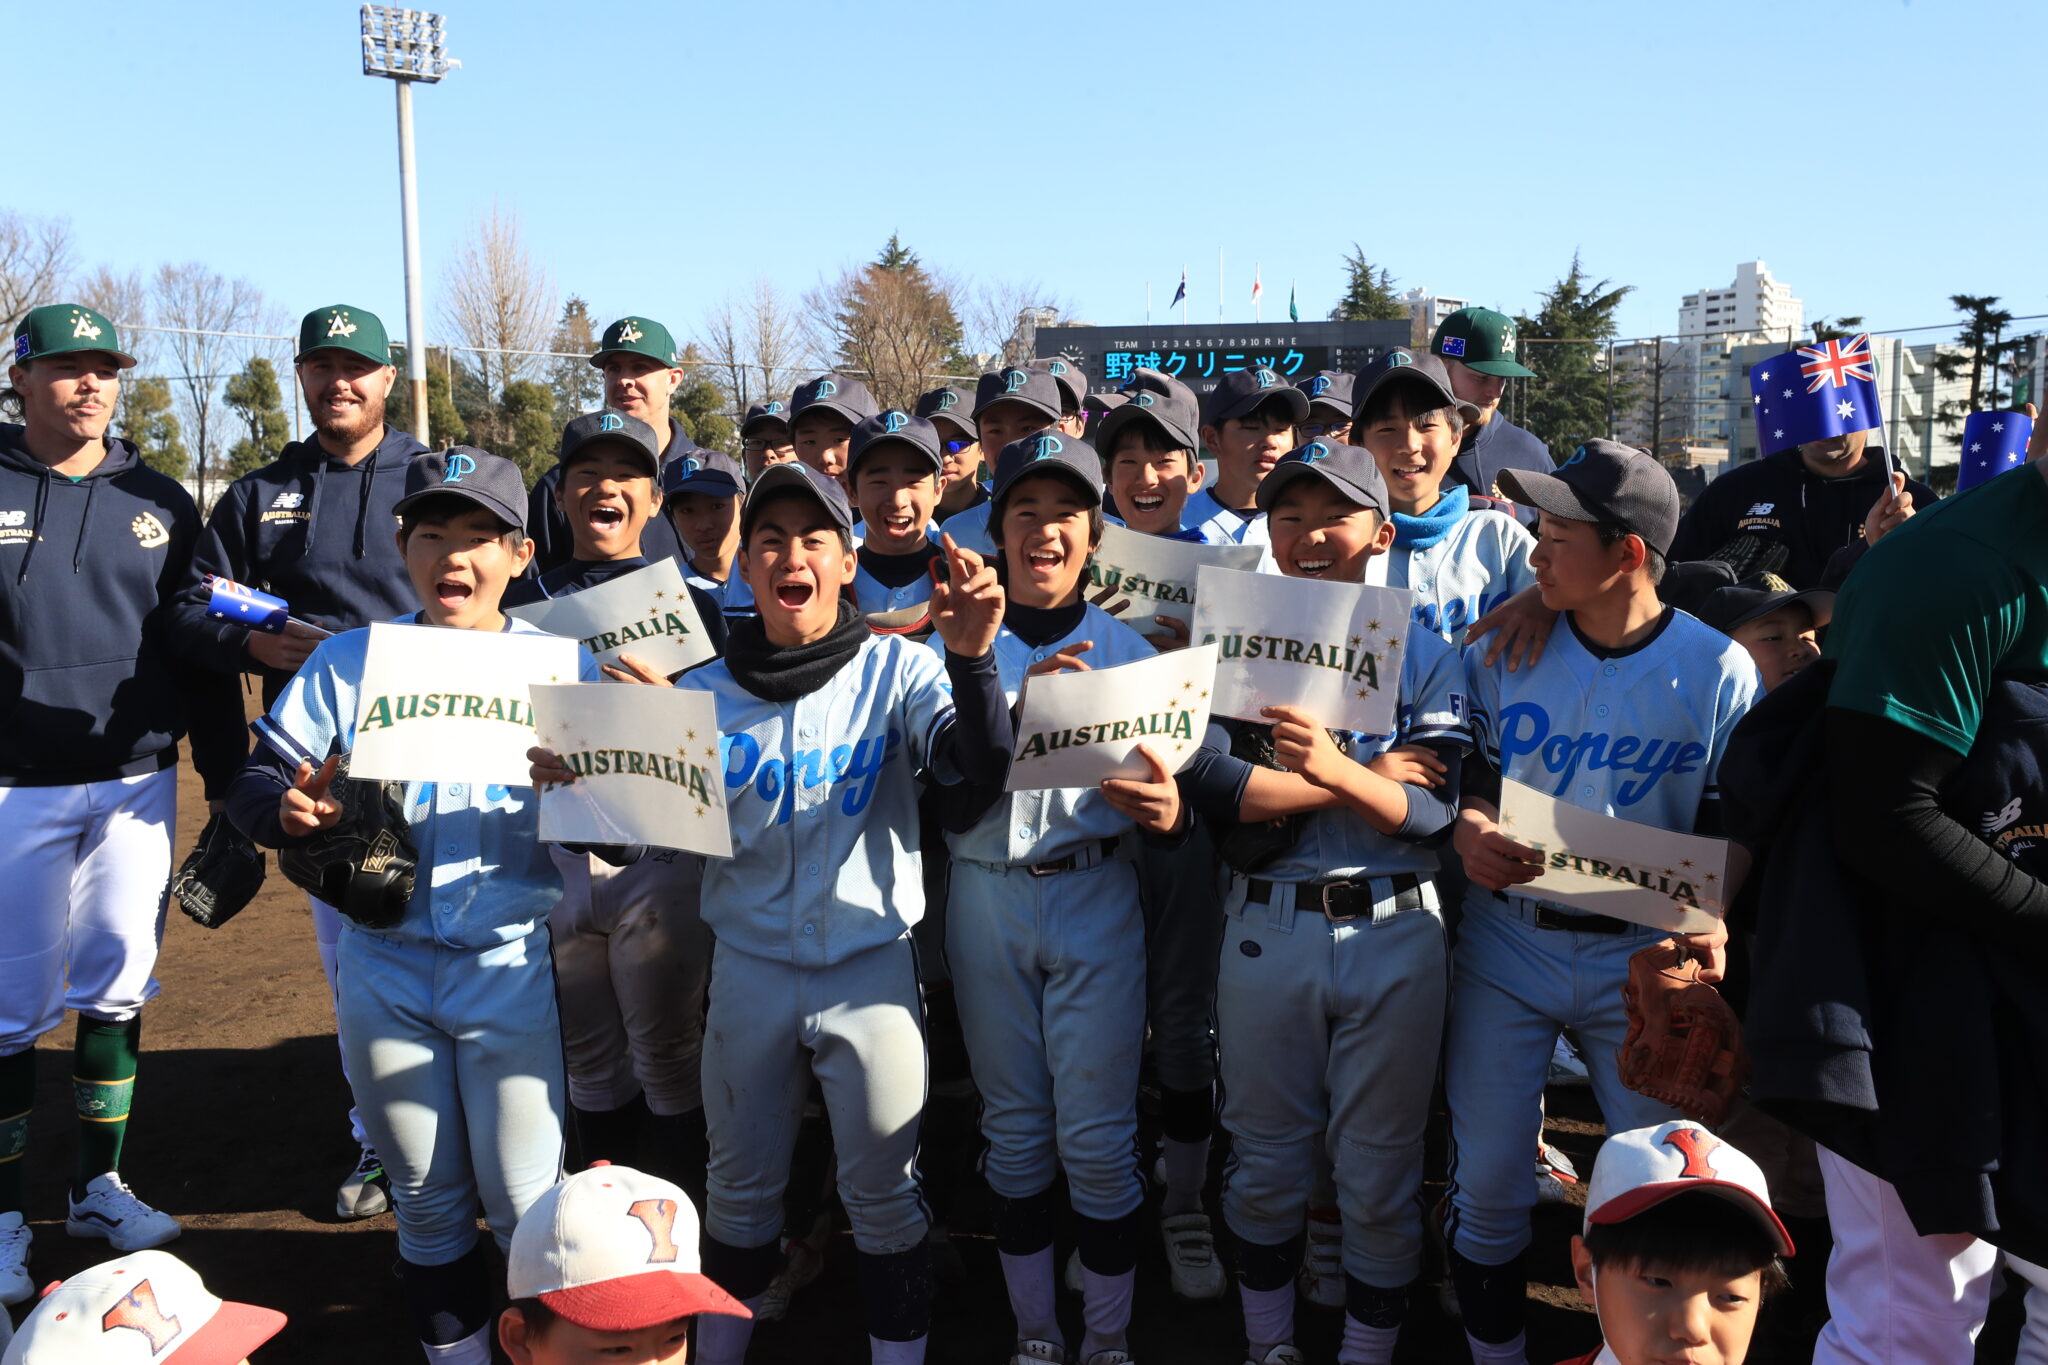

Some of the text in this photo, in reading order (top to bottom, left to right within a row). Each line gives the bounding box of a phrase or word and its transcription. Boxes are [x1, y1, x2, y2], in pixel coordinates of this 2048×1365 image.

[1114, 341, 1139, 349] TEAM
[1173, 340, 1179, 348] 3
[1240, 338, 1246, 346] 9
[1250, 338, 1259, 346] 10
[1265, 338, 1271, 346] R
[1291, 337, 1297, 345] E
[1105, 350, 1304, 379] 野球クリニック
[260, 511, 311, 522] AUSTRALIA
[1737, 518, 1781, 529] AUSTRALIA
[1089, 564, 1196, 604] AUSTRA
[580, 612, 690, 654] TRALIA
[359, 694, 538, 734] AUSTRALI
[1015, 710, 1193, 761] AUSTRALIA
[1500, 702, 1707, 806] Popeye
[1505, 849, 1701, 909] STRALIA
